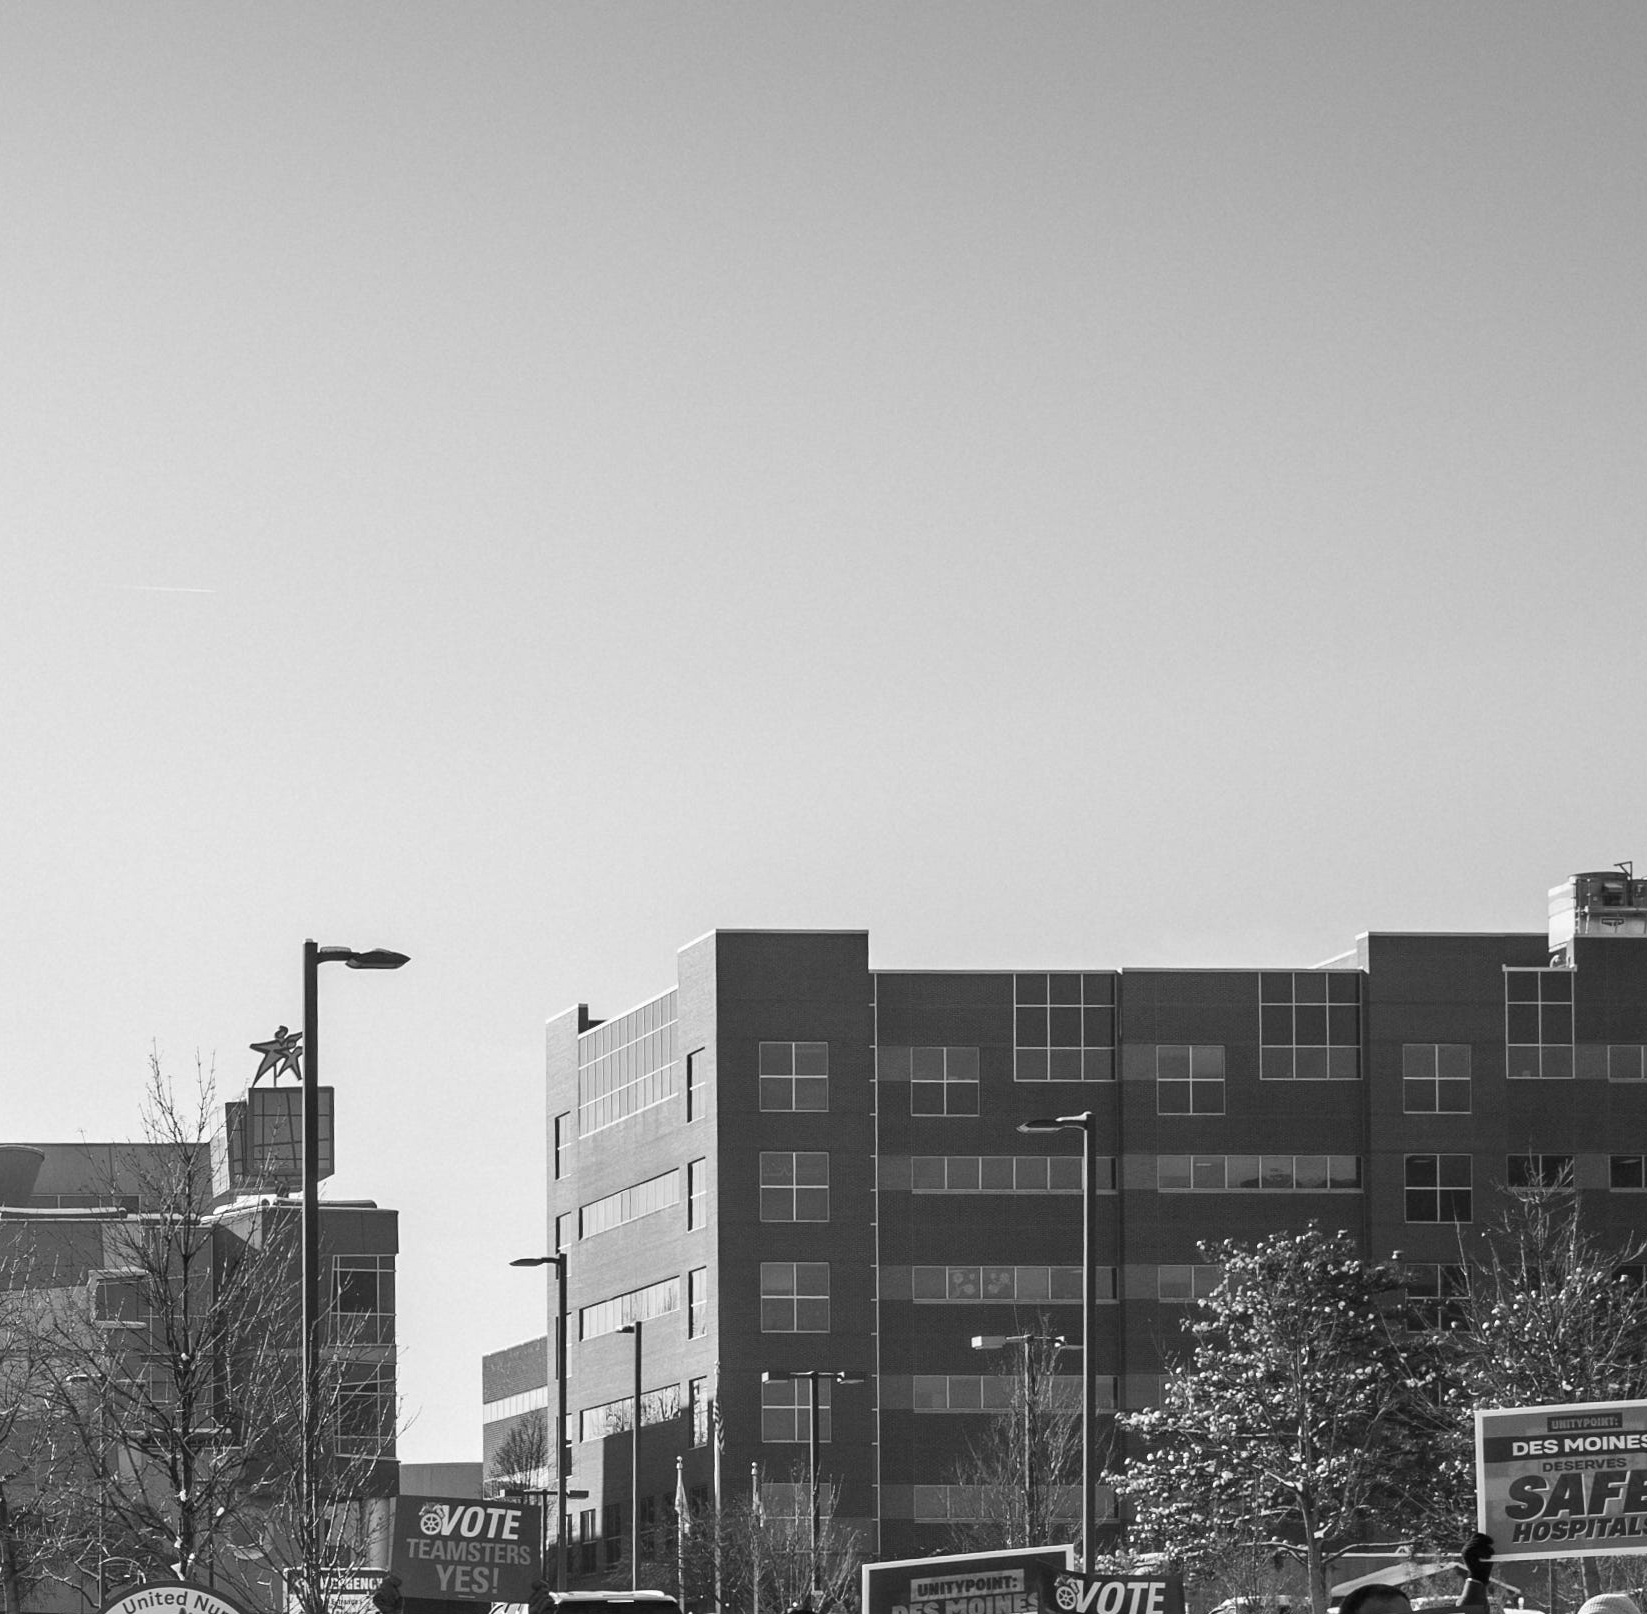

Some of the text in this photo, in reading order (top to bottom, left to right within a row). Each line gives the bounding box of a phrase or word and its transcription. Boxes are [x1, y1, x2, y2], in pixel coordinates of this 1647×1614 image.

[1551, 1418, 1618, 1430] UNITYPOINT:
[1512, 1441, 1558, 1457] DES
[1542, 1457, 1627, 1472] DESERVES
[439, 1505, 522, 1540] VOTE
[406, 1538, 531, 1566] TEAMSTERS
[435, 1563, 500, 1595] YES!
[917, 1573, 1018, 1598] UNITYPOINT:
[122, 1591, 188, 1614] United
